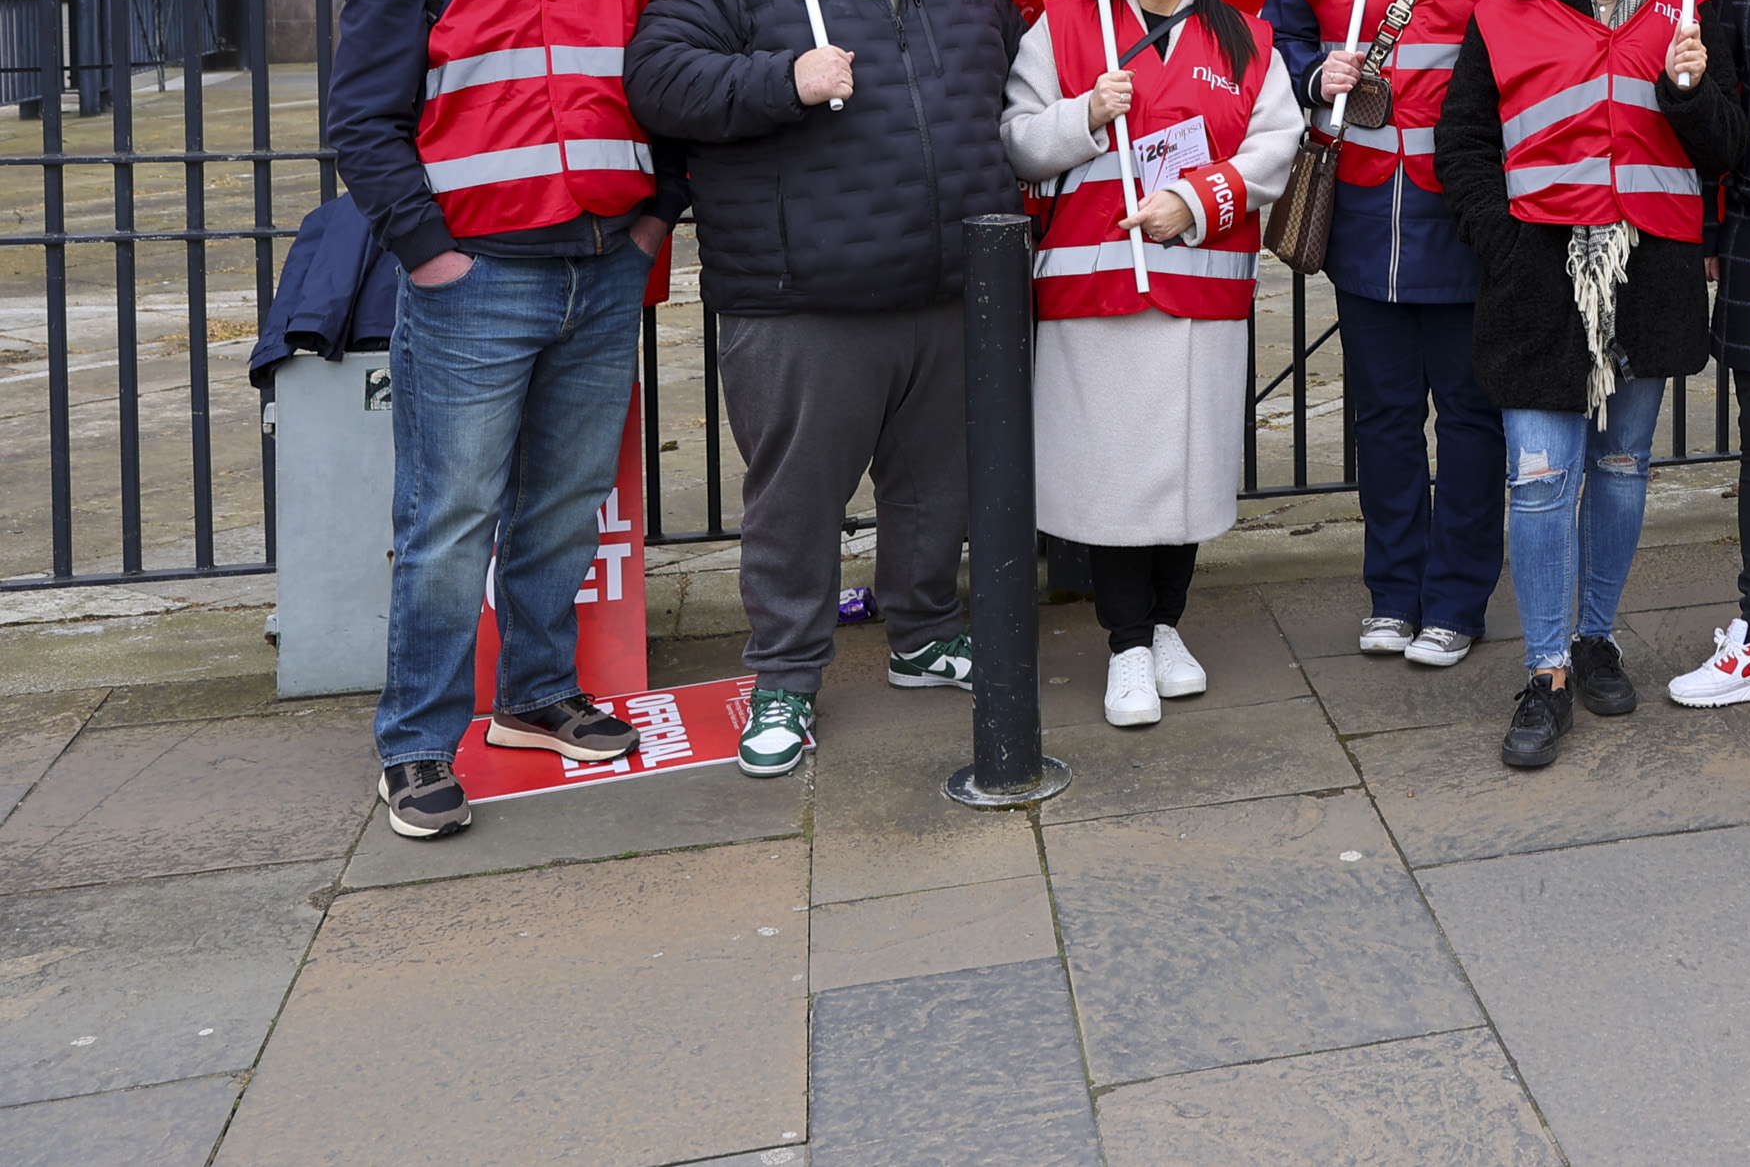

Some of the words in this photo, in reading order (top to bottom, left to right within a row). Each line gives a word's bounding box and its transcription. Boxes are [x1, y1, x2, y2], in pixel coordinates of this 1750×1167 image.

[1654, 1, 1699, 25] nip
[1192, 66, 1240, 95] nipsa
[1205, 172, 1235, 232] PICKET
[625, 693, 694, 769] OFFICIAL
